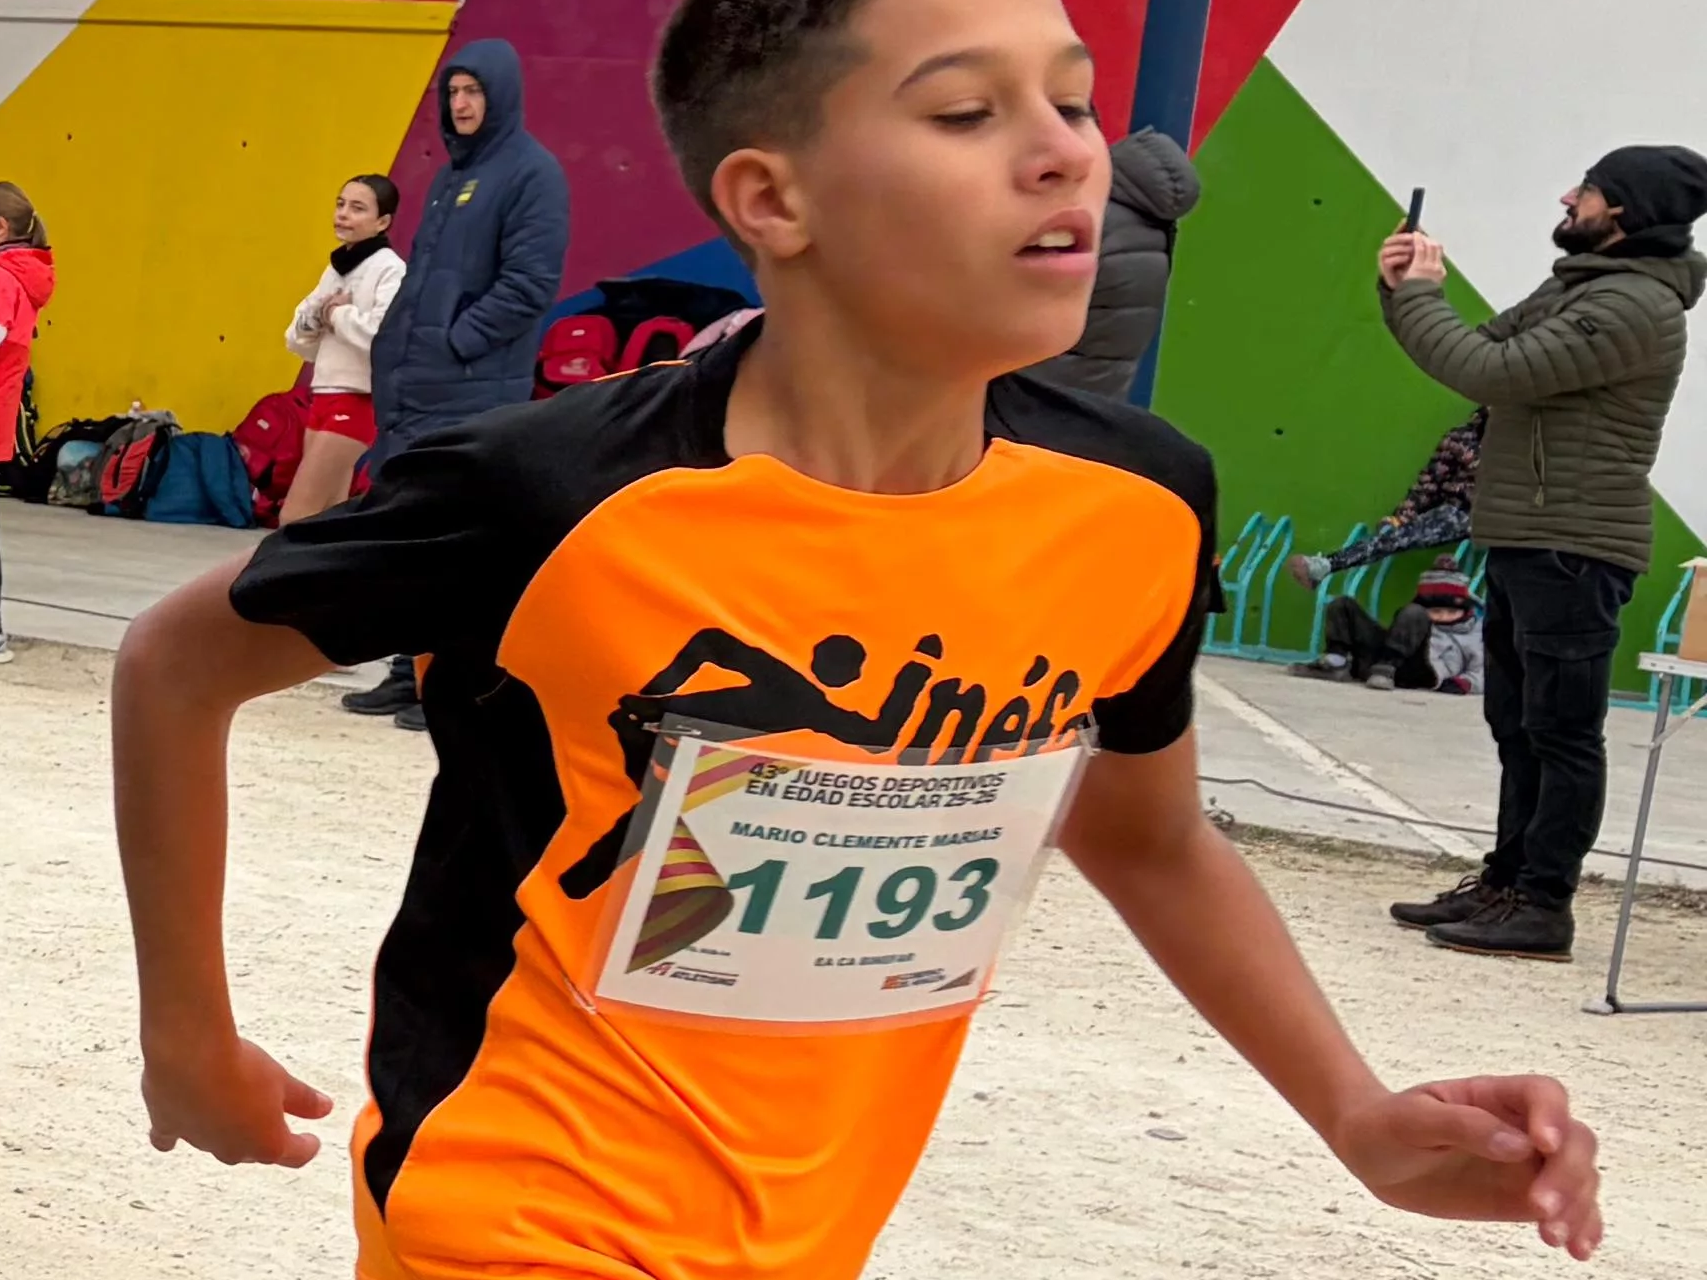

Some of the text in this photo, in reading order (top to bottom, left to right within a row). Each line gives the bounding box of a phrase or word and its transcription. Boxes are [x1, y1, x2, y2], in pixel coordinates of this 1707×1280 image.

[745, 780, 778, 797] EN
[782, 785, 844, 806] EDAD
[847, 791, 943, 809] ESCOLAR
[790, 769, 880, 792] JUEGOS
[882, 772, 1007, 793] DEPORTIVOS
[730, 821, 808, 845] MARIO
[812, 832, 925, 850] CLEMENTE
[727, 857, 1000, 940] 1193
